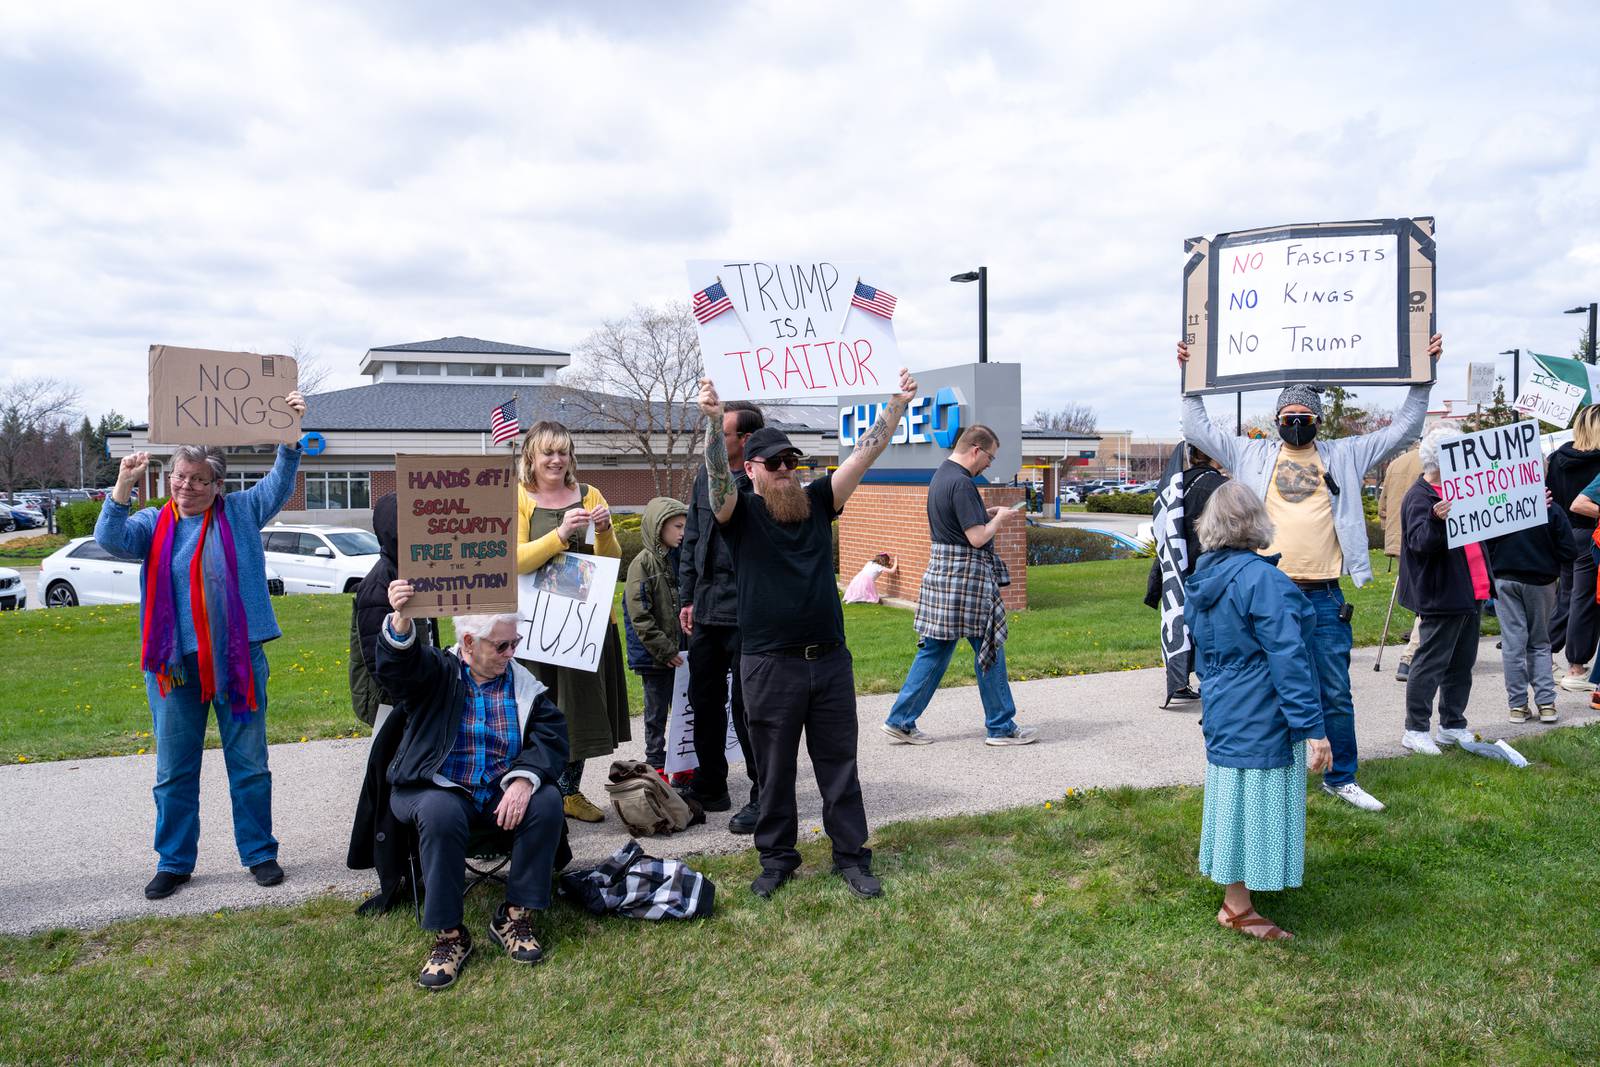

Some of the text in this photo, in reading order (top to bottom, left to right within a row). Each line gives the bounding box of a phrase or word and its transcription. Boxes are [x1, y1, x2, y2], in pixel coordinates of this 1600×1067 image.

[1232, 252, 1264, 274] NO
[723, 262, 839, 312] TRUMP
[1229, 289, 1258, 311] NO
[770, 317, 817, 339] IS A
[1228, 331, 1259, 355] NO
[724, 339, 879, 391] TRAITOR
[200, 363, 250, 391] NO
[1530, 372, 1560, 391] ICE
[175, 395, 294, 429] KINGS
[1441, 423, 1535, 472] TRUMP
[408, 468, 511, 490] HANDS OFF!
[1443, 460, 1541, 502] DESTROYING
[412, 498, 470, 516] SOCIAL
[1488, 493, 1507, 506] OUR
[427, 516, 512, 535] SECURITY
[1448, 495, 1538, 538] DEMOCRACY
[410, 540, 508, 561] FREE PRESS
[408, 572, 508, 593] CONSTITUTION
